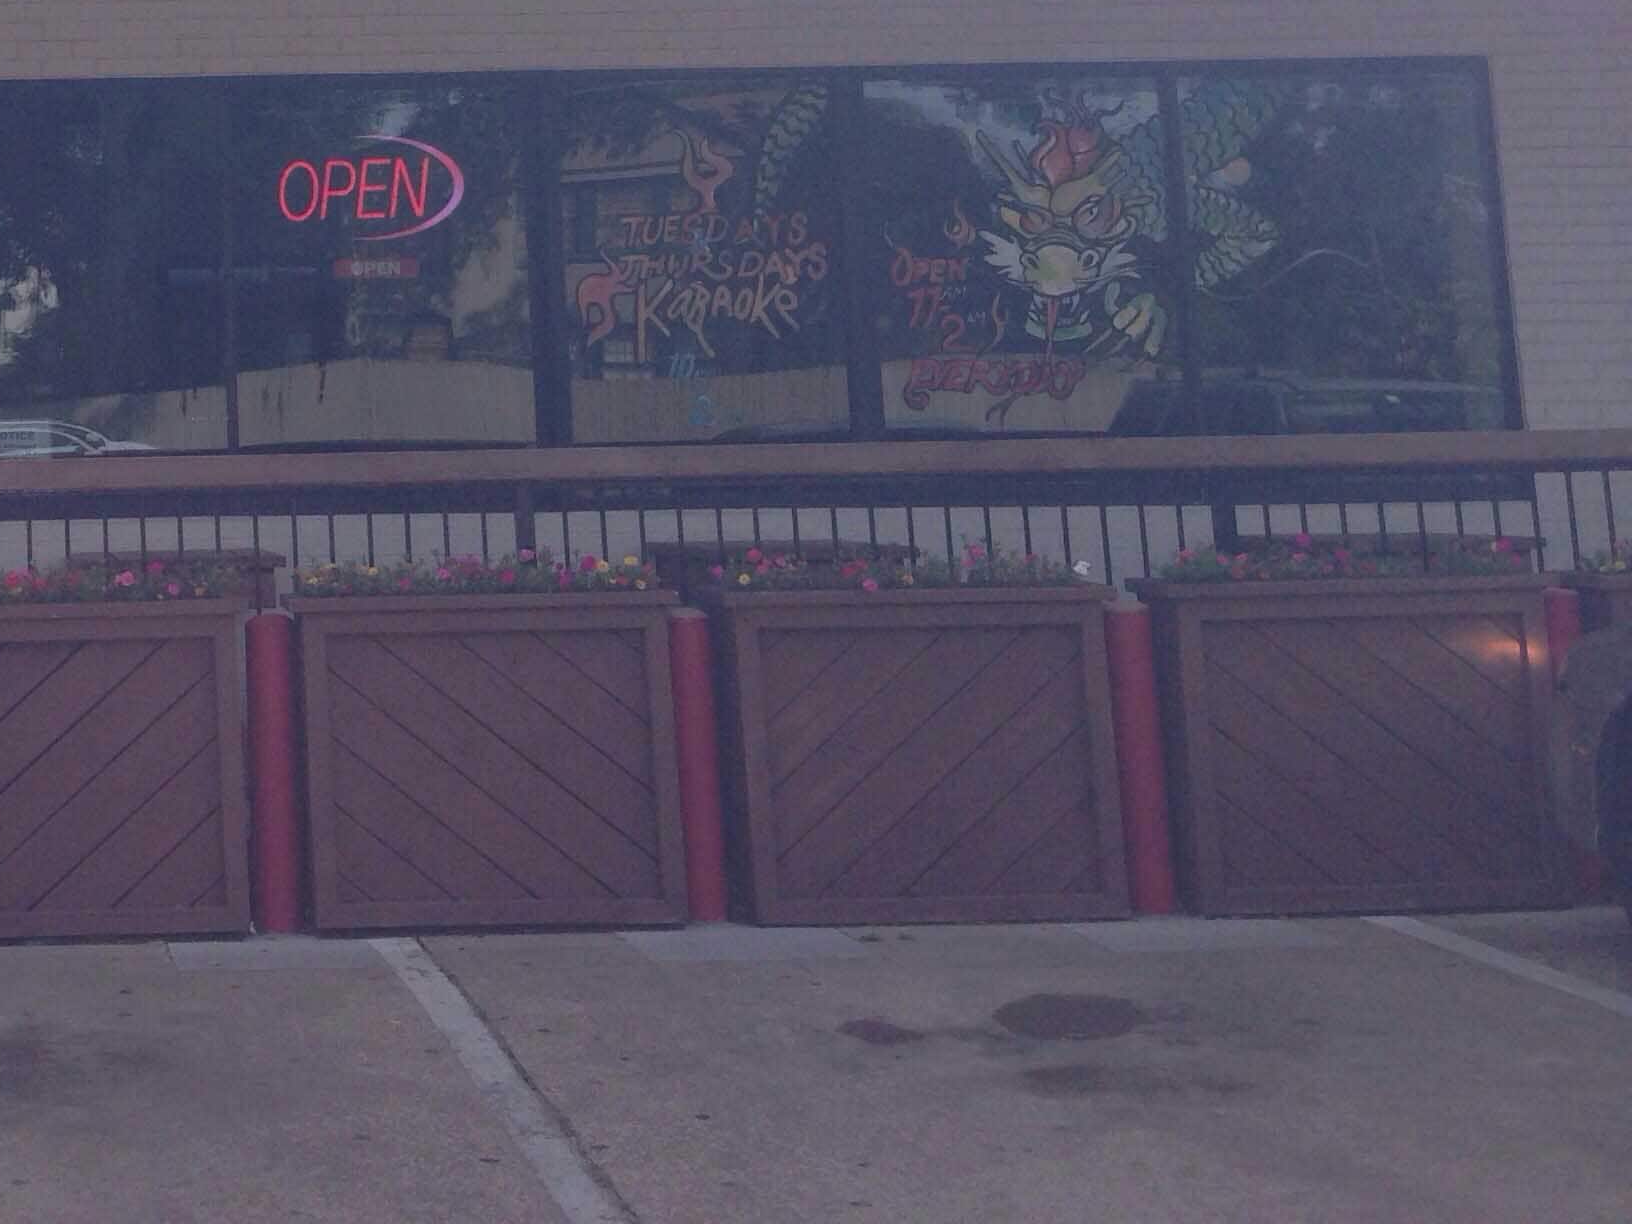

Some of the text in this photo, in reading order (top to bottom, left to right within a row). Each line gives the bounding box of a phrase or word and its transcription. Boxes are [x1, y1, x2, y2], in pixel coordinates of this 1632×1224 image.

[277, 155, 430, 222] OPEN
[620, 210, 809, 250] TUESDAYS
[350, 260, 400, 276] OPEN
[618, 242, 831, 286] THURSDAYS
[938, 313, 976, 353] 2
[904, 358, 1088, 418] EVERYDAY
